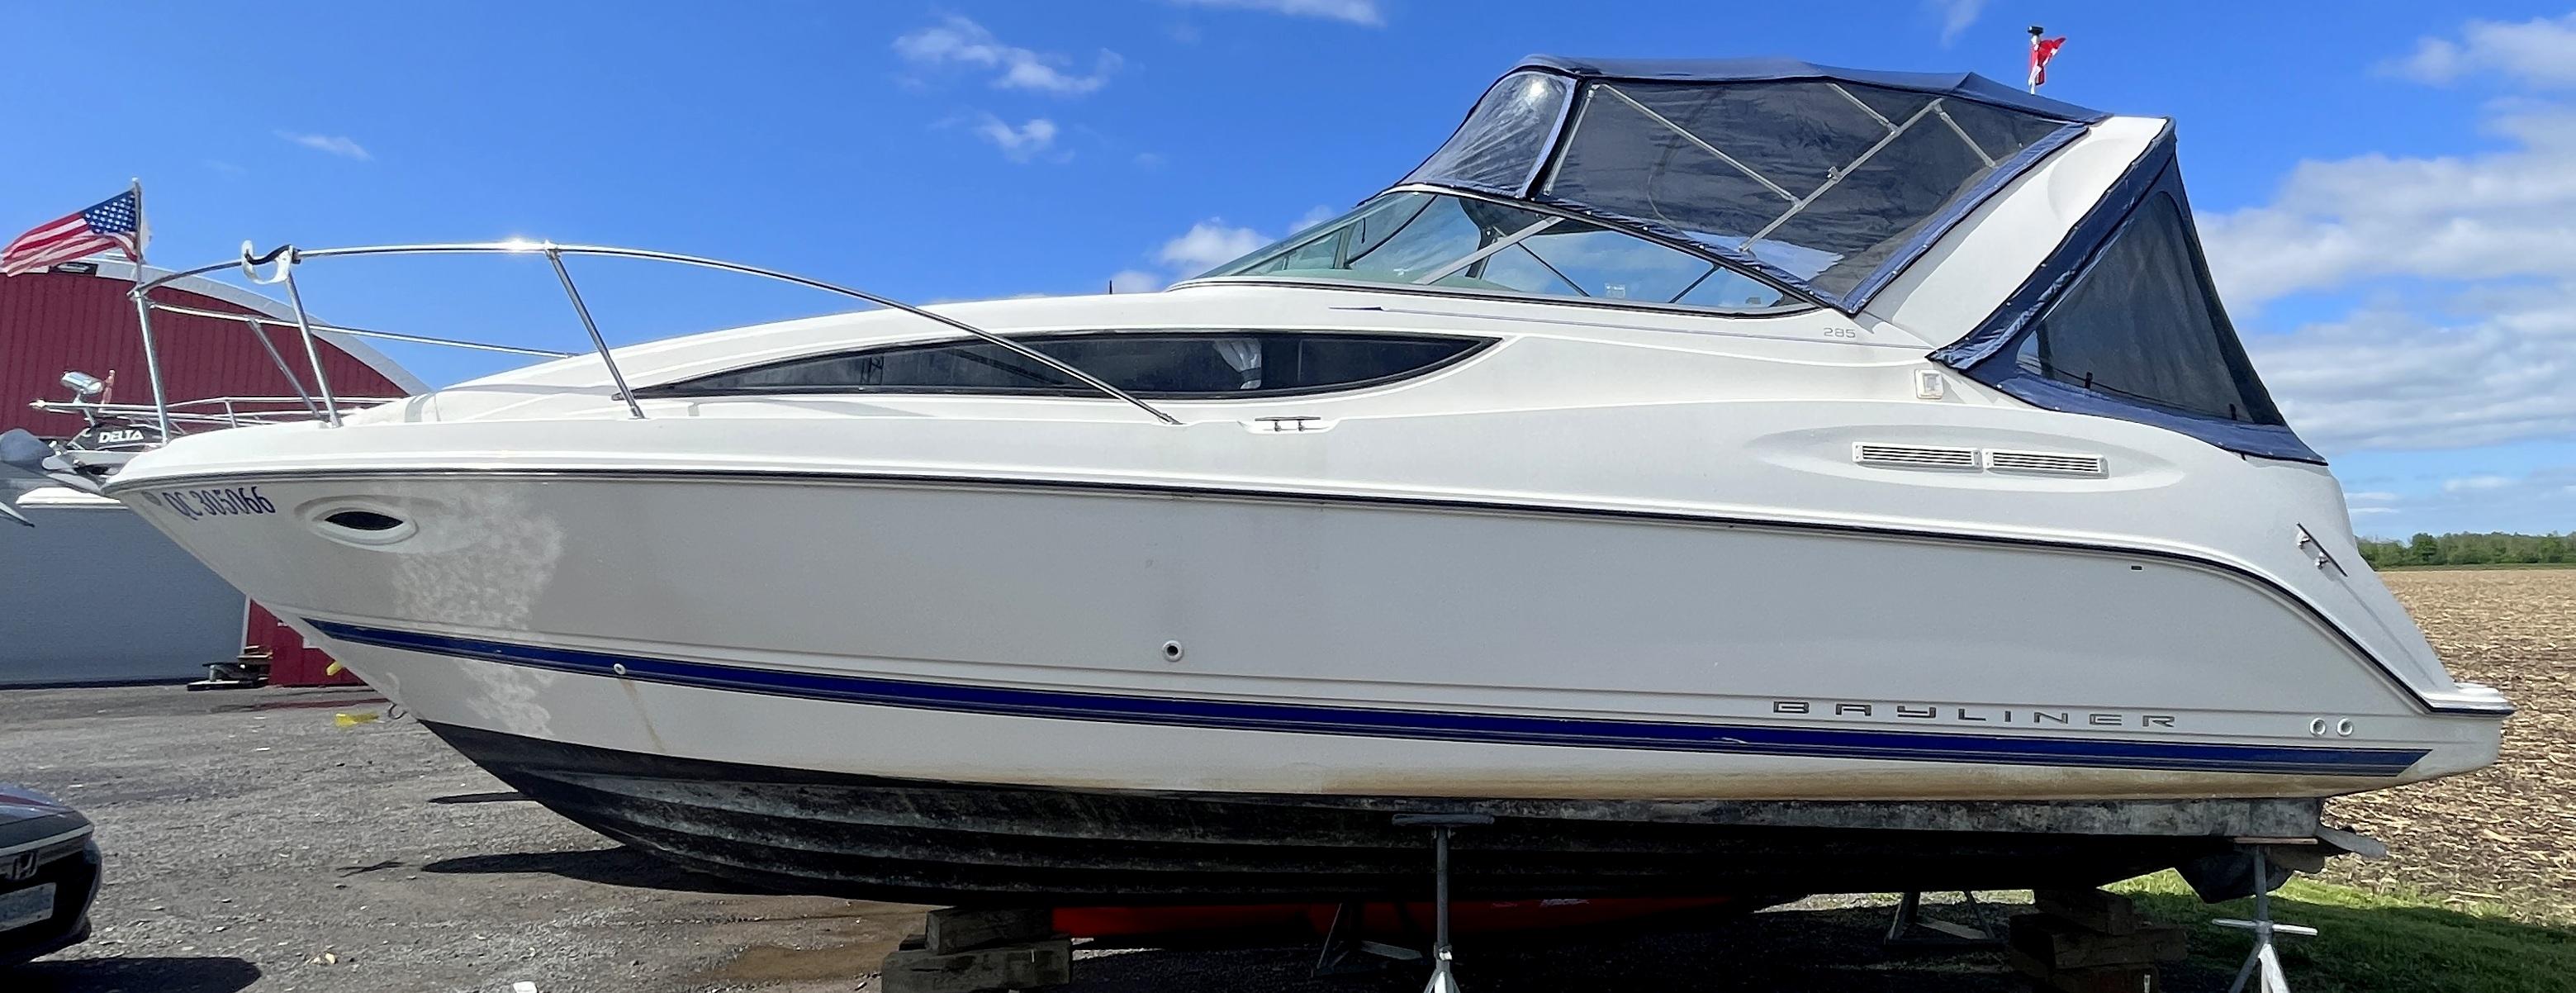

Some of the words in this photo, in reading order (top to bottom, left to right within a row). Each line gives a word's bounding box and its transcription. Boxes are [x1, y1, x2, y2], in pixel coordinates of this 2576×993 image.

[1823, 327, 1856, 338] 285
[98, 430, 144, 443] DELTA
[1773, 701, 2175, 727] BAYLINER
